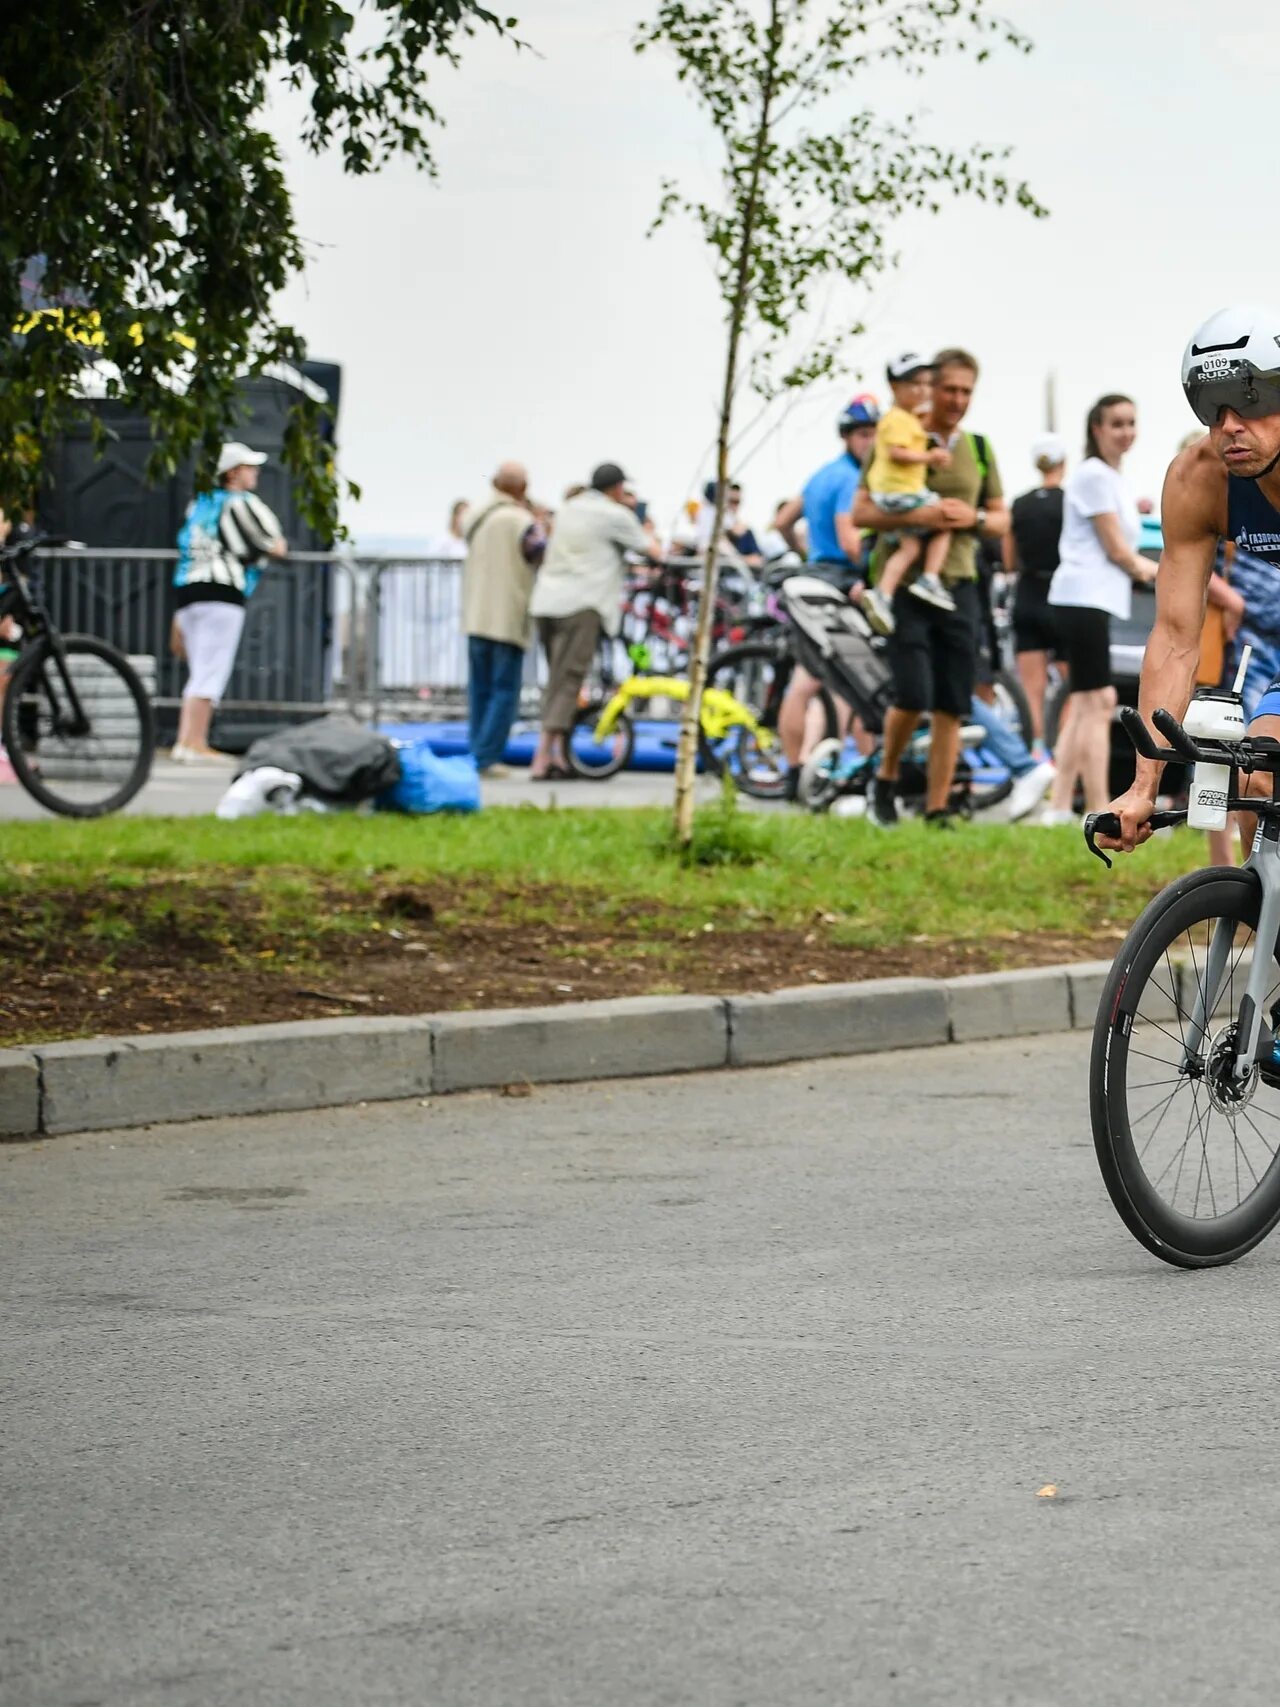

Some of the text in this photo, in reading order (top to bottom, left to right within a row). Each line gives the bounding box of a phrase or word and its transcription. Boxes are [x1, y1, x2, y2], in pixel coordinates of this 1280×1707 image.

[1203, 357, 1229, 371] 0109
[1197, 366, 1240, 380] RUDY
[1252, 817, 1265, 853] BMC
